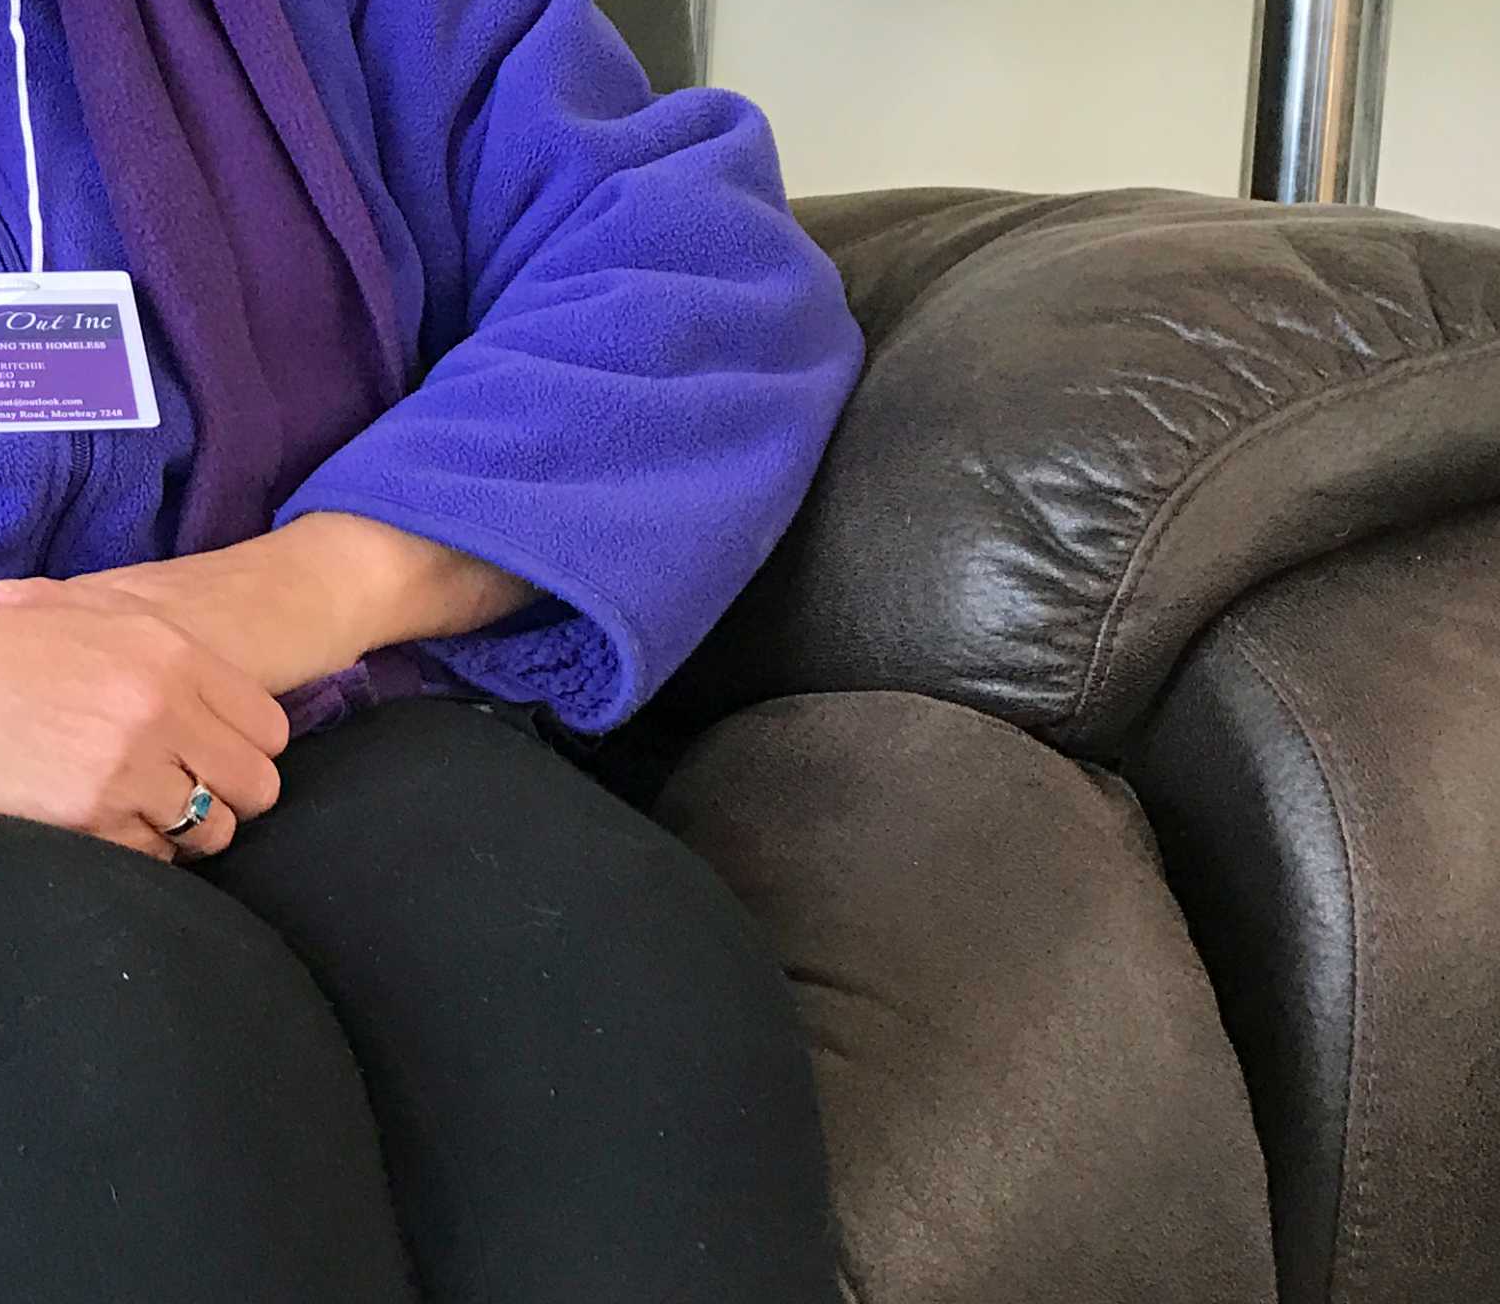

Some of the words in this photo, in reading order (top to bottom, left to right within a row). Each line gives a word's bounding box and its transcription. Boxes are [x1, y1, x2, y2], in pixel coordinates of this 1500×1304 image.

[6, 311, 66, 331] Out
[72, 312, 112, 329] Inc
[19, 341, 43, 350] THE
[45, 341, 107, 350] HOMELESS
[0, 361, 46, 370] RITCHIE
[19, 410, 49, 419] Road,
[51, 409, 97, 419] Mowbray
[99, 409, 124, 417] 7248
